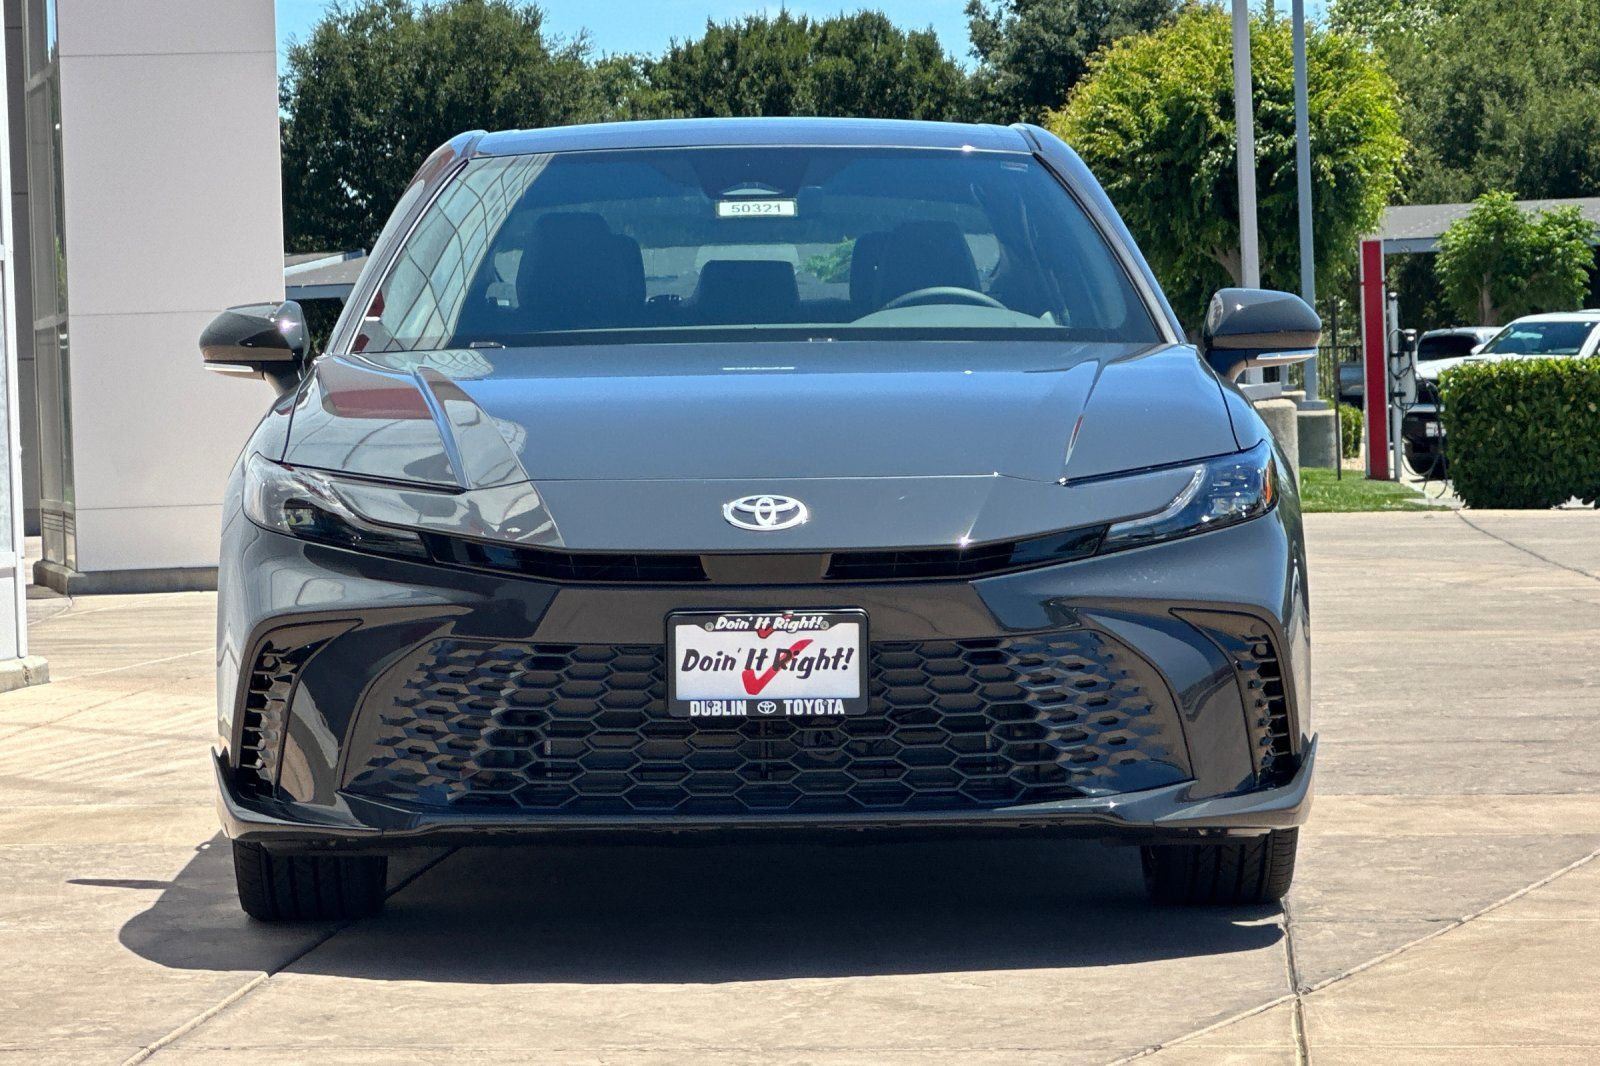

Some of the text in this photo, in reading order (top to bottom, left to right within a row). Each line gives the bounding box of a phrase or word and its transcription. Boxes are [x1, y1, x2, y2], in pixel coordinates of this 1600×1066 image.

[731, 203, 781, 213] 50321
[715, 616, 824, 633] Doin' It Right!
[681, 648, 854, 679] Doin' It Right!
[690, 699, 845, 716] DUBLIN TOYOTA
